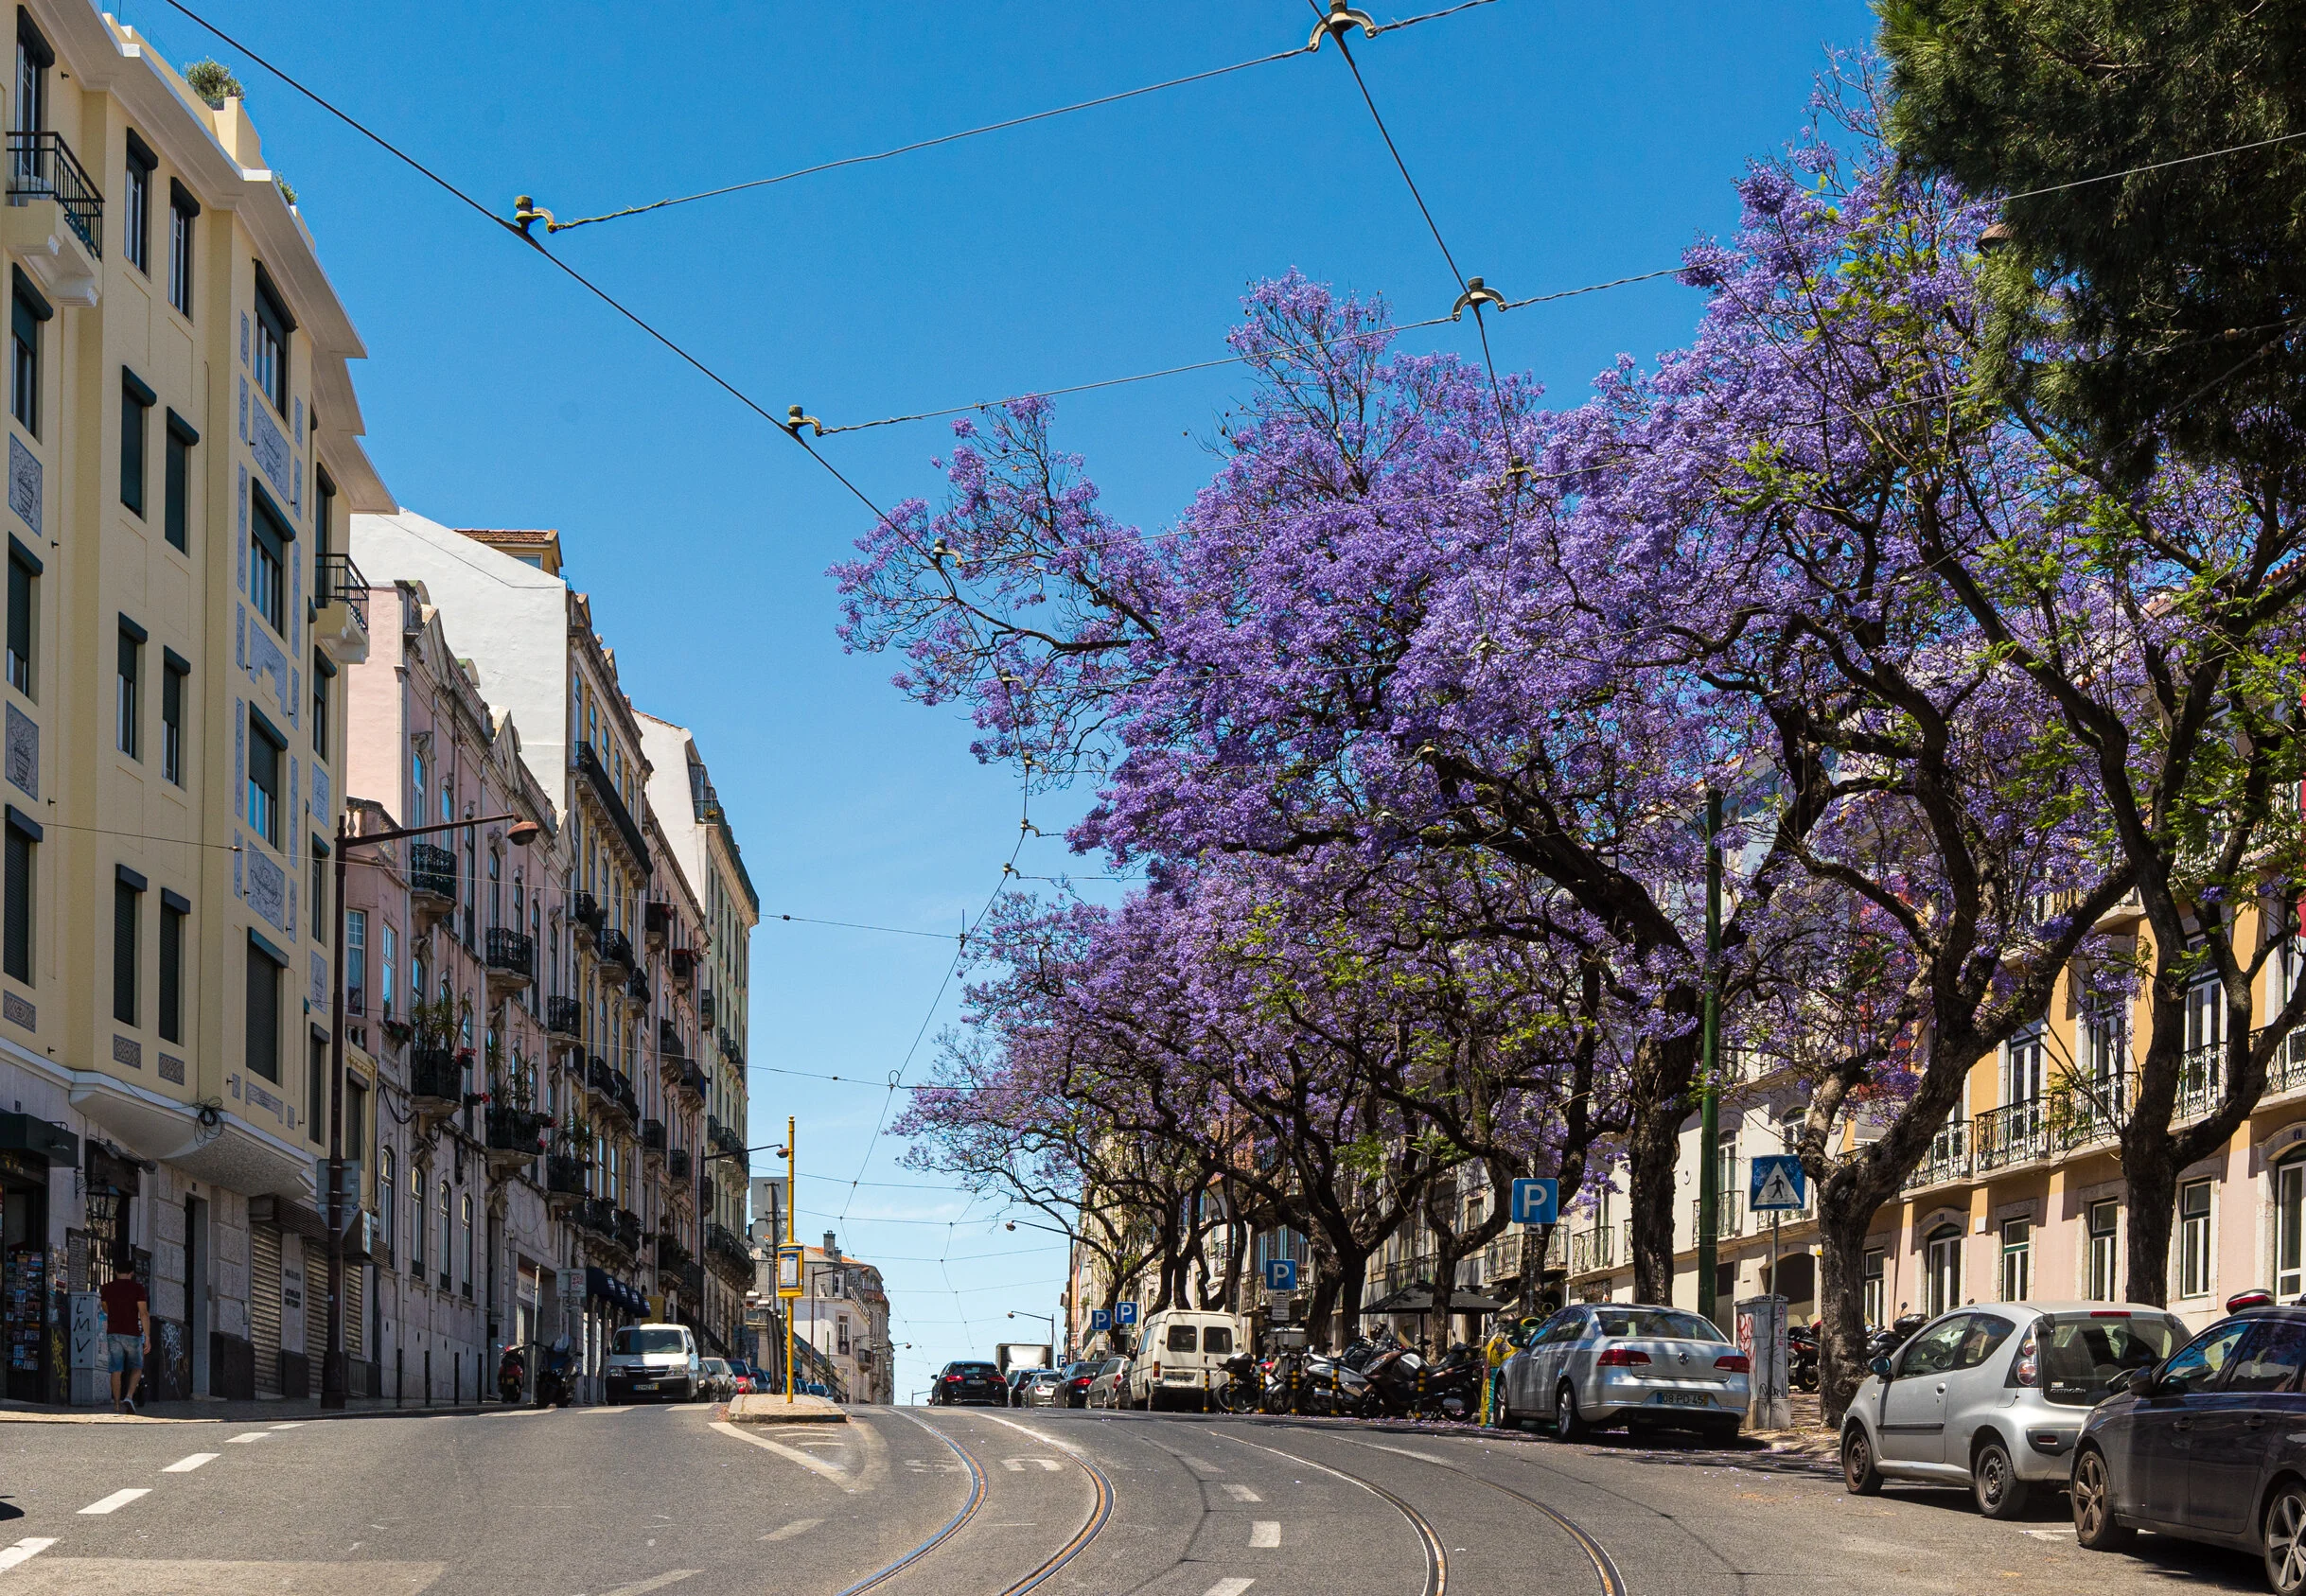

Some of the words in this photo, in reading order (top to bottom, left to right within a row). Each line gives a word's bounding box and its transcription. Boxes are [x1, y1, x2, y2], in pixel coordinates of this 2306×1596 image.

[1524, 1184, 1547, 1218] P
[1274, 1264, 1289, 1286] P
[1096, 1312, 1107, 1328] P
[1120, 1305, 1133, 1322] P
[1060, 1357, 1066, 1366] P
